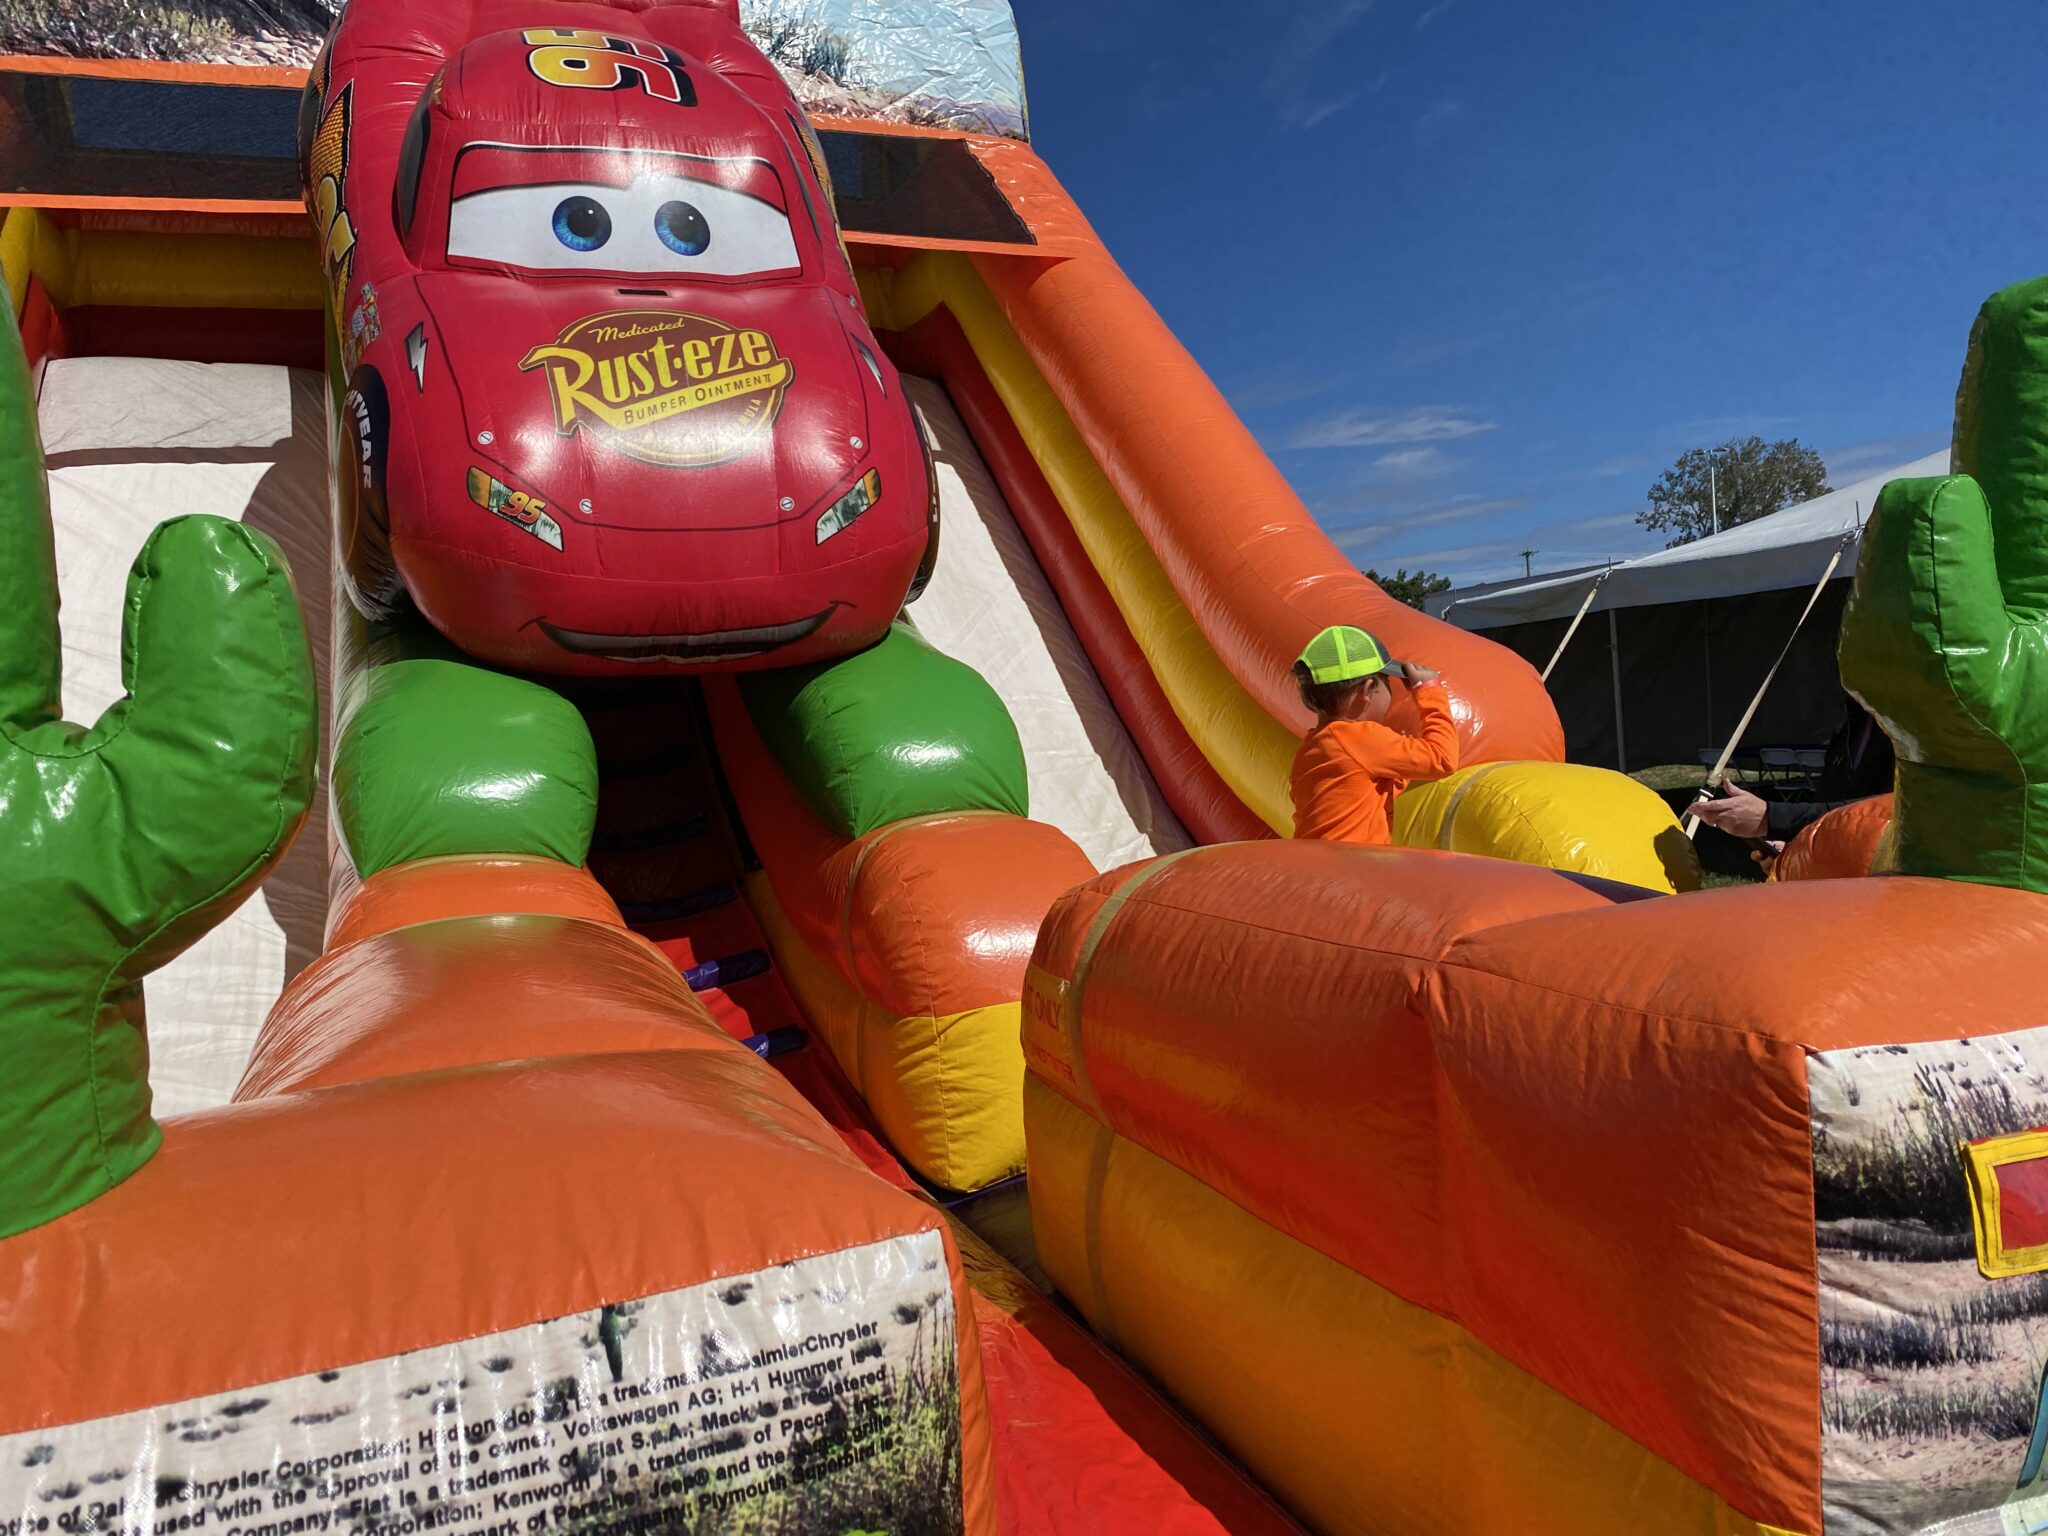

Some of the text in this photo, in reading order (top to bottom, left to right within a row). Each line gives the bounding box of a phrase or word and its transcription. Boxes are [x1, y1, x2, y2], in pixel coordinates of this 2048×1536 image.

[588, 317, 686, 344] Medicated
[623, 373, 773, 425] BUMPER OINTMENT
[499, 491, 546, 525] 95
[1036, 991, 1062, 1032] ONLY
[57, 1504, 81, 1528] of
[276, 1438, 410, 1481] Corporation;
[598, 1392, 608, 1407] a
[737, 1321, 878, 1370] aimlerChrysler
[153, 1506, 205, 1536] used
[215, 1496, 262, 1522] with
[272, 1488, 307, 1510] the
[316, 1461, 409, 1500] approval
[419, 1456, 439, 1475] of
[449, 1449, 480, 1469] the
[563, 1400, 680, 1441] Volkswagen
[688, 1387, 723, 1411] AG;
[731, 1376, 760, 1399] H-1
[768, 1356, 843, 1389] Hummer
[350, 1493, 390, 1517] Fiat
[400, 1489, 417, 1508] is
[428, 1485, 439, 1501] a
[448, 1455, 550, 1496] trademark
[559, 1446, 579, 1468] of
[587, 1437, 624, 1460] Fiat
[701, 1405, 750, 1432] Mack
[782, 1396, 794, 1410] a
[802, 1363, 887, 1405] registered
[493, 1474, 590, 1513] Kenworth
[600, 1467, 617, 1487] is
[627, 1463, 639, 1479] a
[648, 1434, 745, 1473] trademark
[754, 1423, 771, 1444] of
[527, 1509, 546, 1531] of
[715, 1456, 750, 1481] and
[756, 1449, 786, 1470] the
[699, 1473, 787, 1512] Plymouth
[791, 1442, 876, 1484] Superbird
